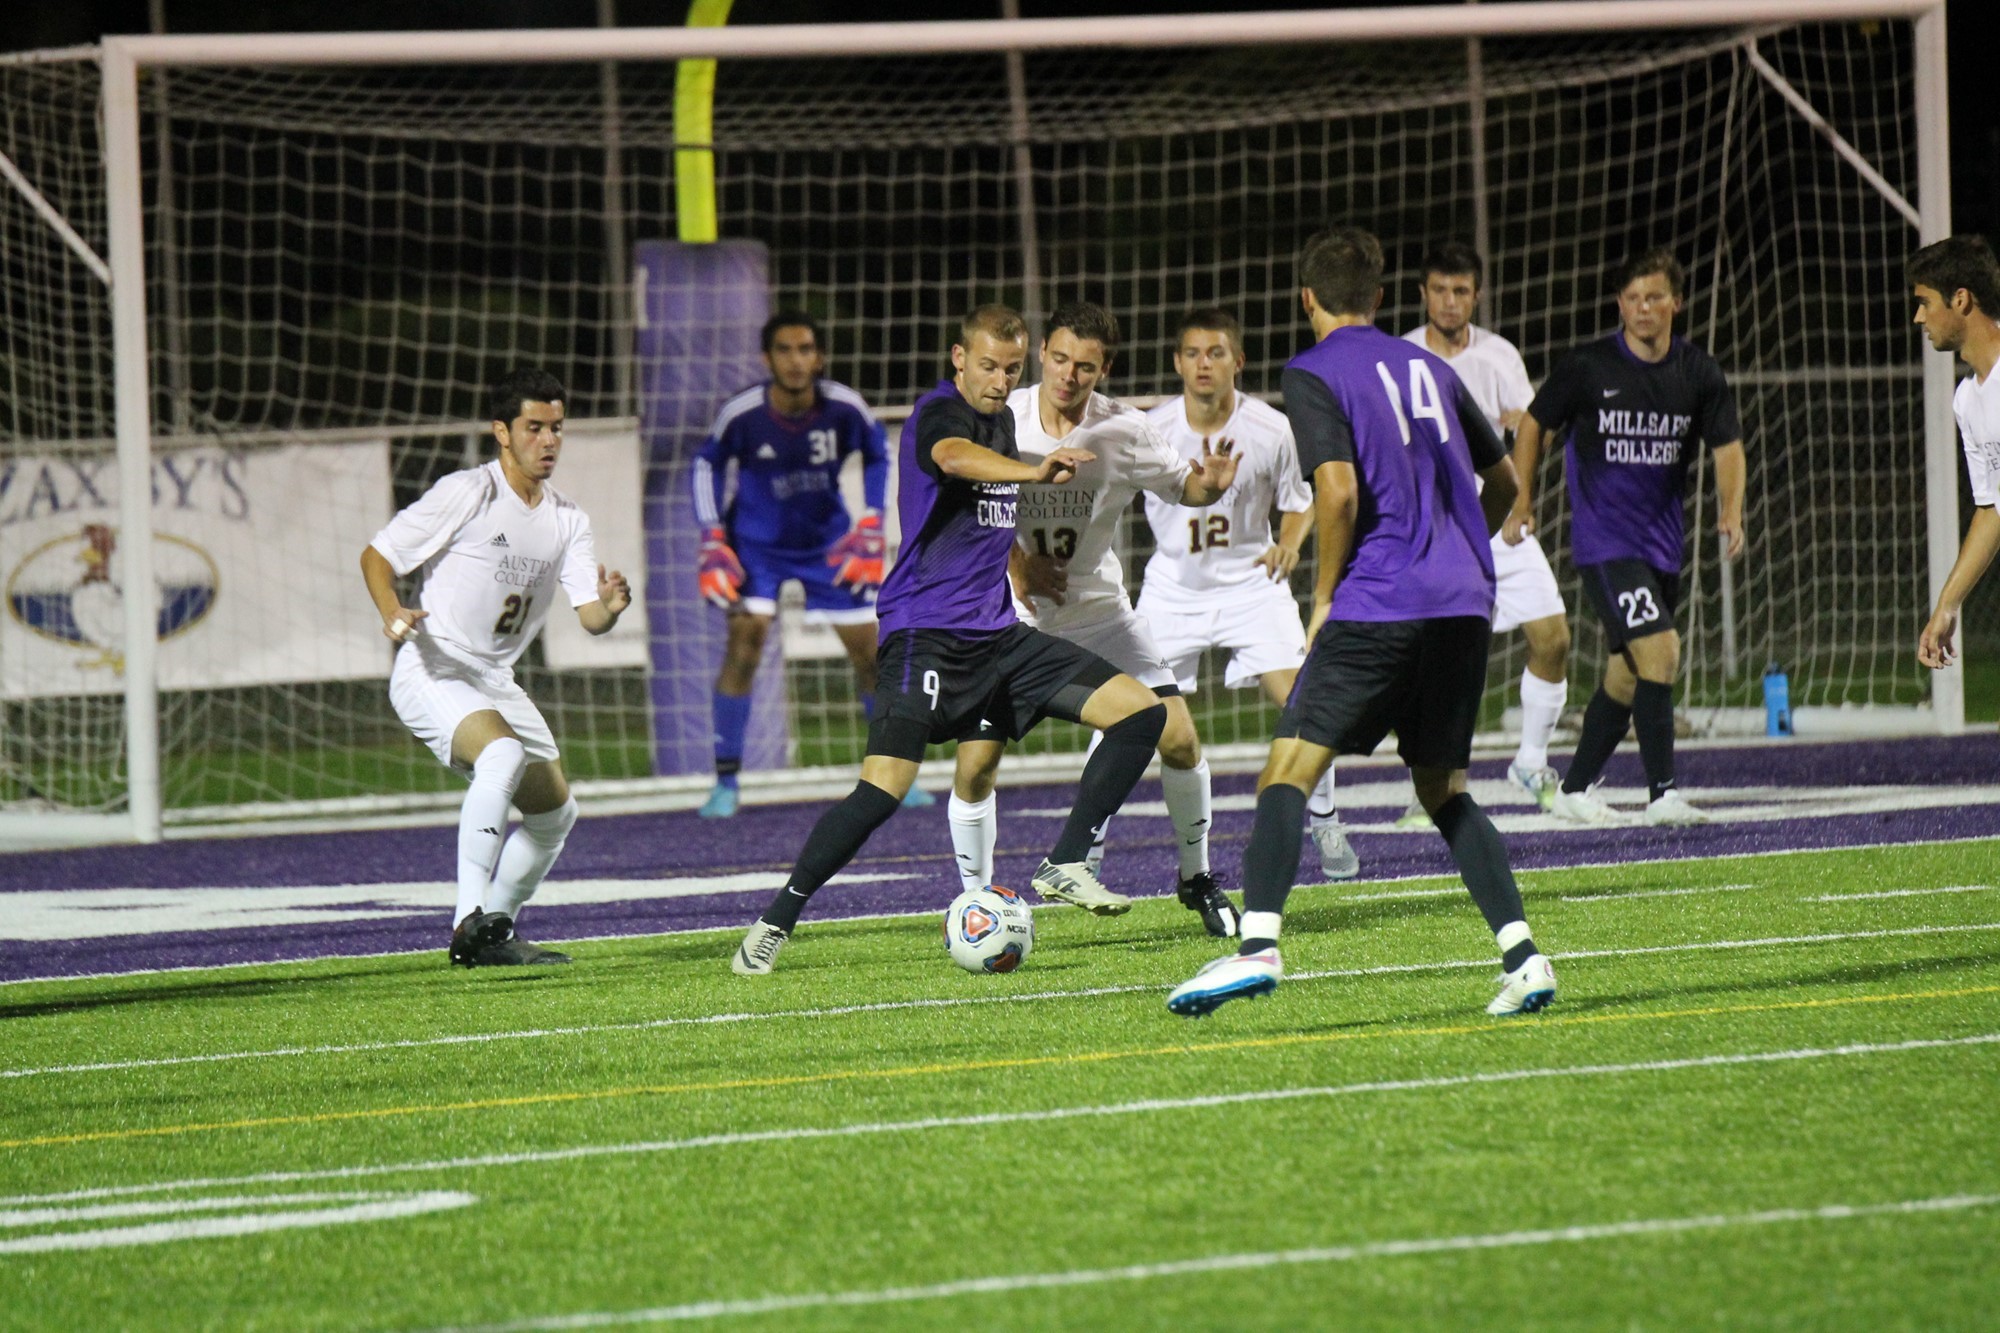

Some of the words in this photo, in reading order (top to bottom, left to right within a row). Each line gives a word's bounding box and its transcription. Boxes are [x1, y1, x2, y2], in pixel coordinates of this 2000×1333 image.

[1376, 359, 1449, 446] 14
[1598, 408, 1691, 437] MILLSAPS
[807, 428, 838, 465] 31
[1605, 438, 1681, 465] COLLEGE
[1017, 505, 1092, 521] COLLEGE
[1018, 489, 1097, 506] AUSTIN
[1032, 527, 1078, 560] 13
[1188, 513, 1231, 554] 12
[498, 554, 554, 574] AUSTIN
[494, 593, 534, 635] 21
[1618, 586, 1660, 629] 23
[923, 669, 940, 711] 9
